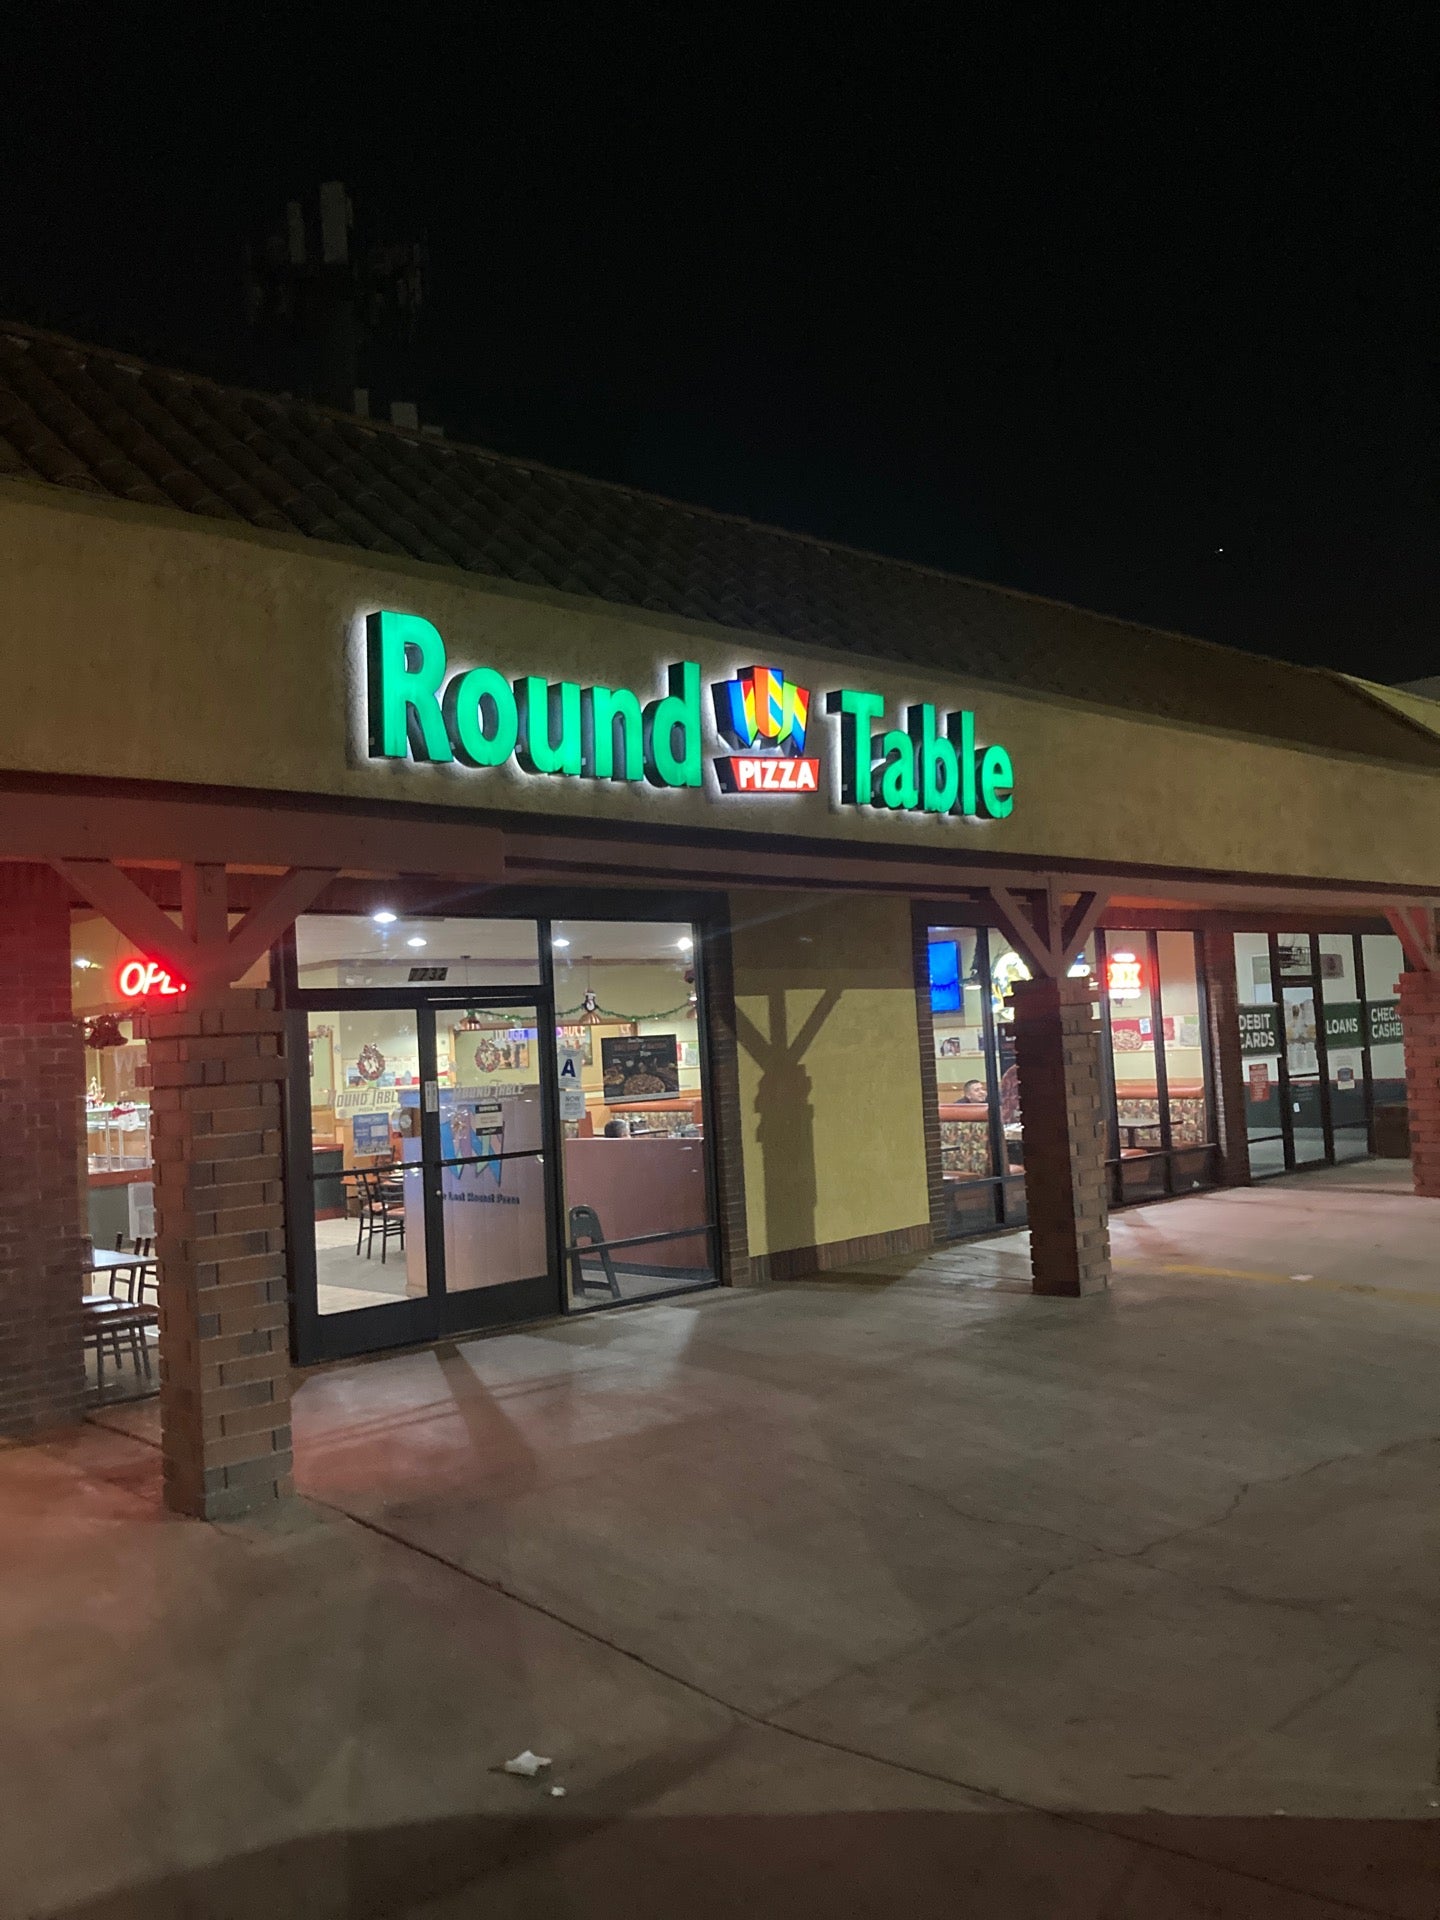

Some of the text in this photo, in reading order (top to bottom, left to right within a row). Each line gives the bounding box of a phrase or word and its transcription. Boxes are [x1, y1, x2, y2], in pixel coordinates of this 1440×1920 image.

[374, 609, 1014, 820] Round Table
[738, 760, 817, 789] PIZZA
[1238, 1013, 1271, 1030] DEBIT
[1326, 1018, 1359, 1035] LOANS
[1372, 1022, 1403, 1038] CASHE
[561, 1058, 576, 1077] A
